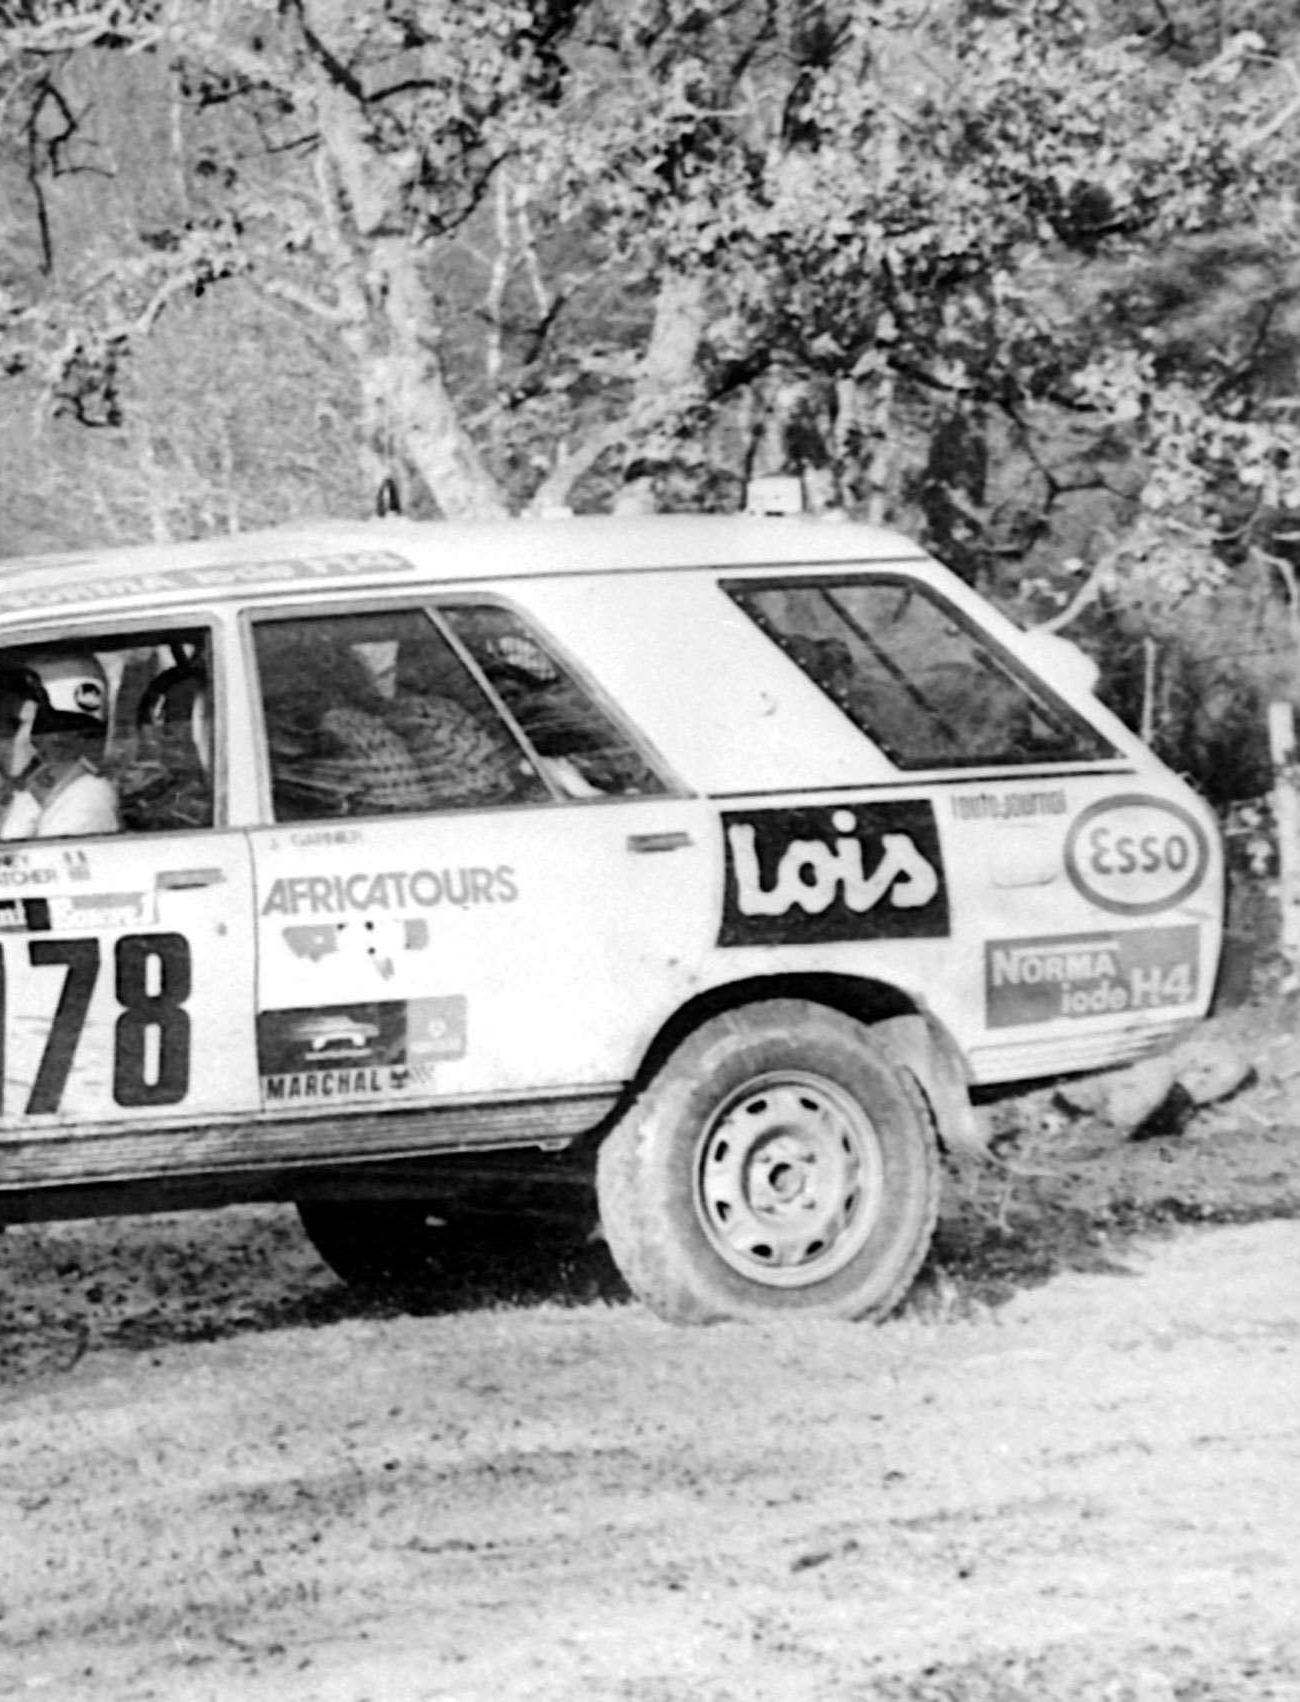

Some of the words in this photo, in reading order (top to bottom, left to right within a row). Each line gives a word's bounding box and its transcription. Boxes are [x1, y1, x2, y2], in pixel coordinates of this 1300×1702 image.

[728, 809, 938, 917] Lois
[261, 864, 519, 917] AFRICATOURS
[266, 1068, 382, 1100] MARCHAL
